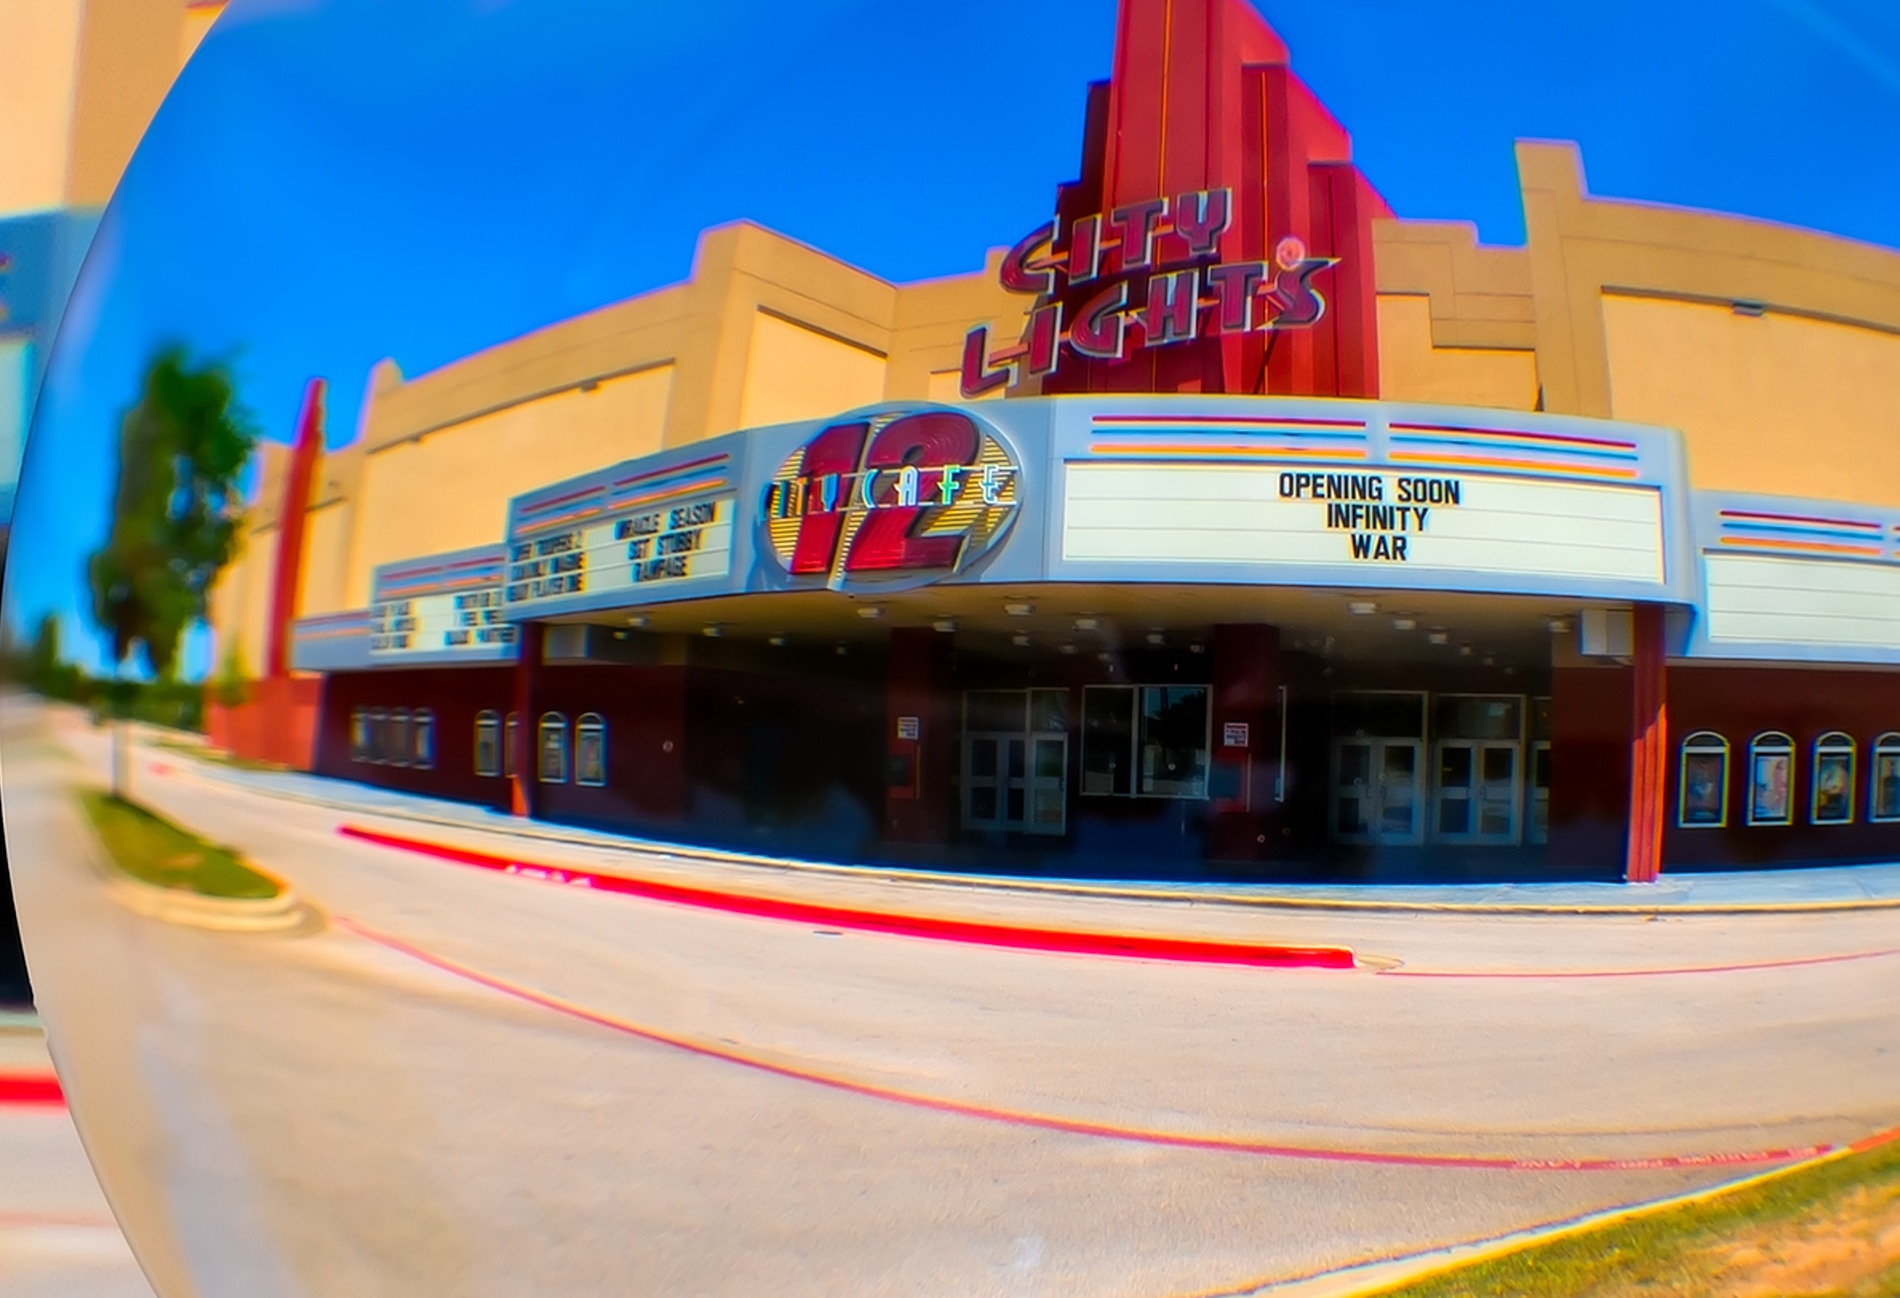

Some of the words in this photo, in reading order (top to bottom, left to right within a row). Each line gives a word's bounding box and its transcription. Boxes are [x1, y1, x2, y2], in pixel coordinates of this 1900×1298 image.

[1000, 188, 1232, 294] CITY
[959, 258, 1342, 399] LIGHTS
[790, 412, 980, 575] 12
[1279, 472, 1382, 501] OPENING
[1397, 477, 1460, 505] SOON
[670, 501, 716, 529] SEASON
[1327, 503, 1428, 532] INFINITY
[656, 529, 702, 556] STUBBY
[1351, 534, 1407, 561] WAR
